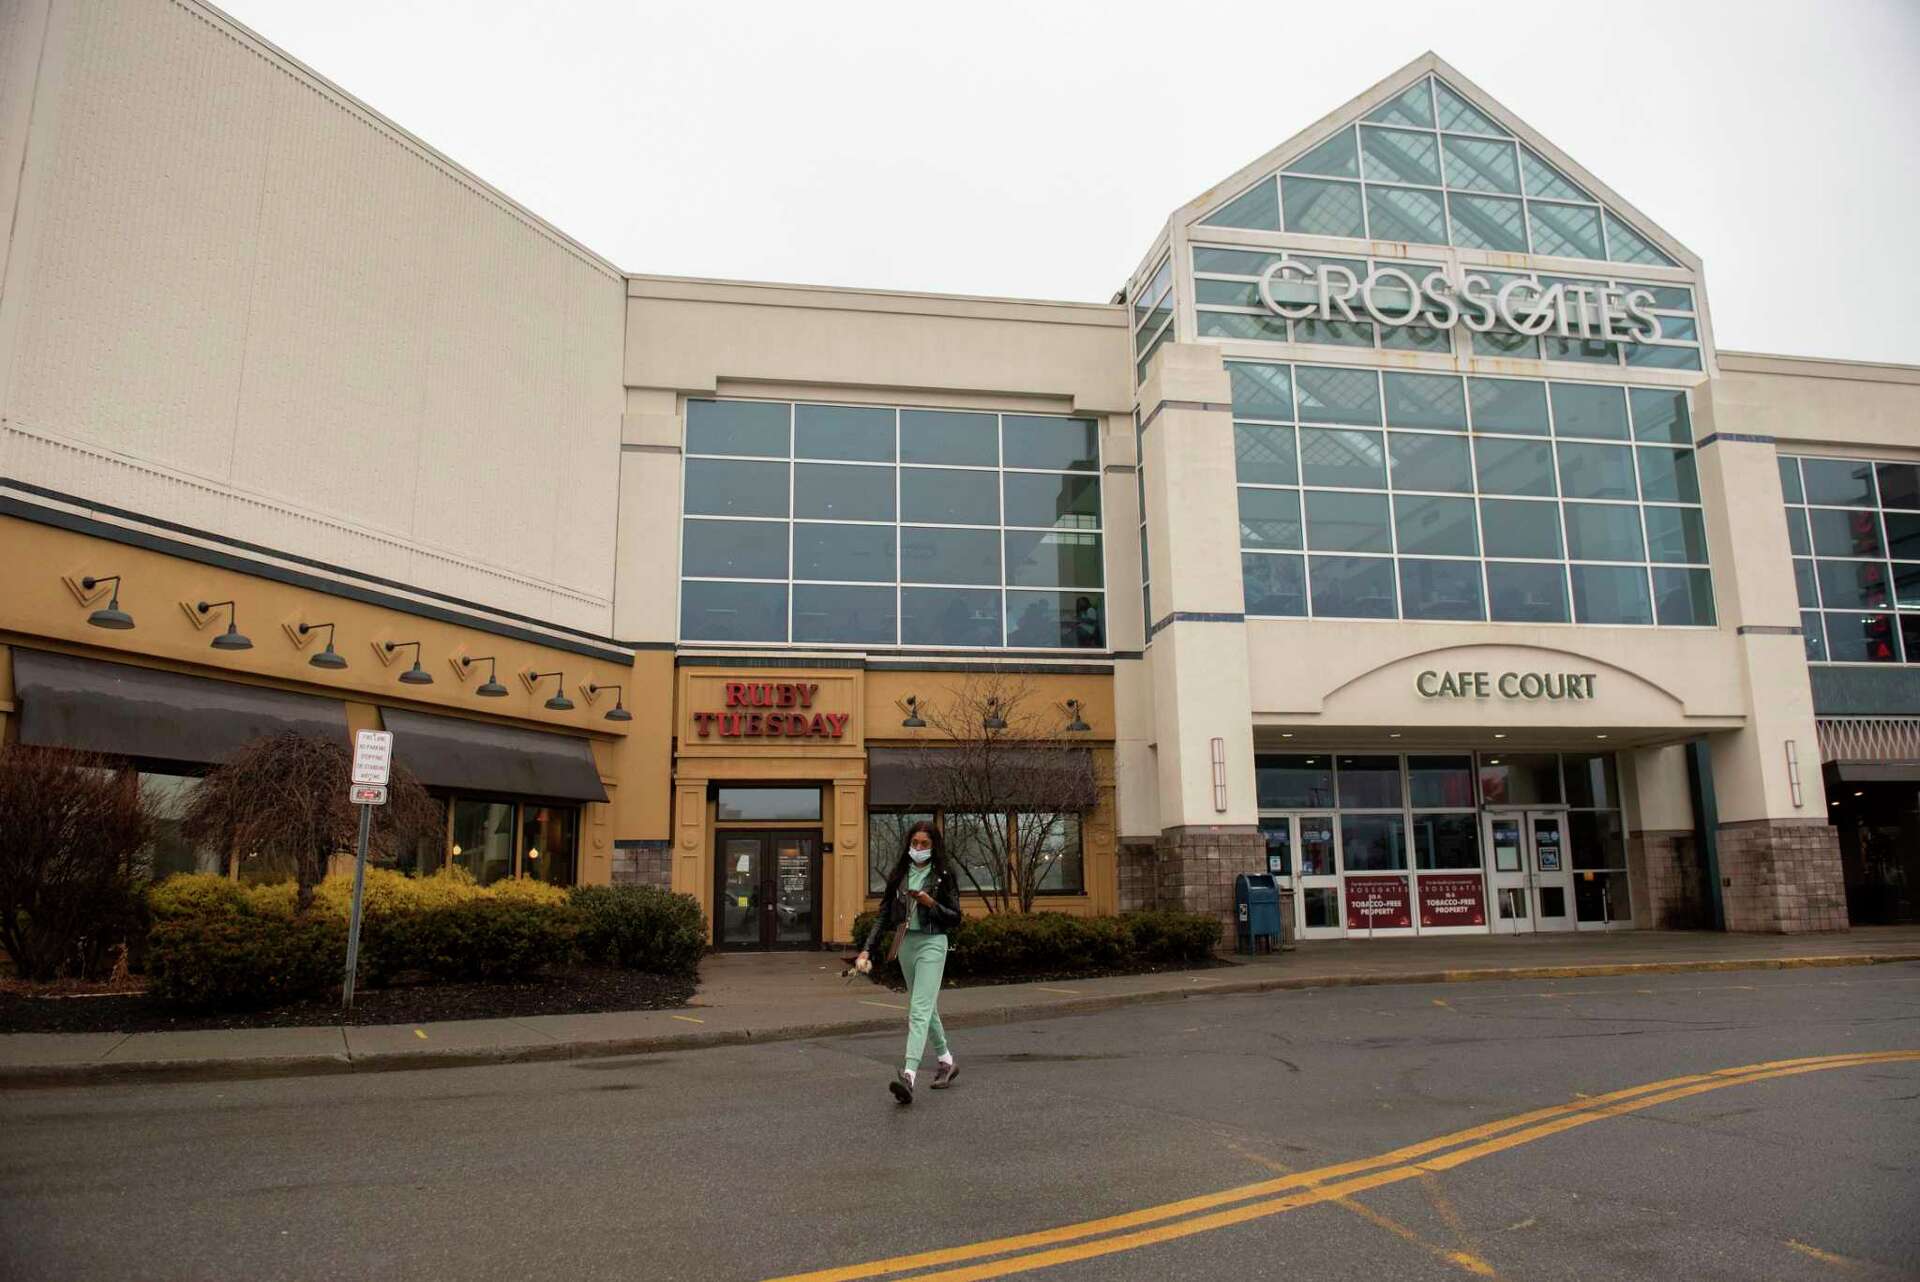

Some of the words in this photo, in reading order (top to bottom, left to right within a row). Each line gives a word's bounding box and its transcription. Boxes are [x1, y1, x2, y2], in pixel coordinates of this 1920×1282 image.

[1258, 260, 1662, 344] CROSSGATES
[726, 682, 818, 707] RUBY
[1417, 670, 1490, 698] CAFE
[1498, 672, 1596, 699] COURT
[694, 712, 849, 738] TUESDAY
[1351, 900, 1402, 908] TOBACCO-FREE
[1427, 898, 1476, 906] TOBACCO-FREE
